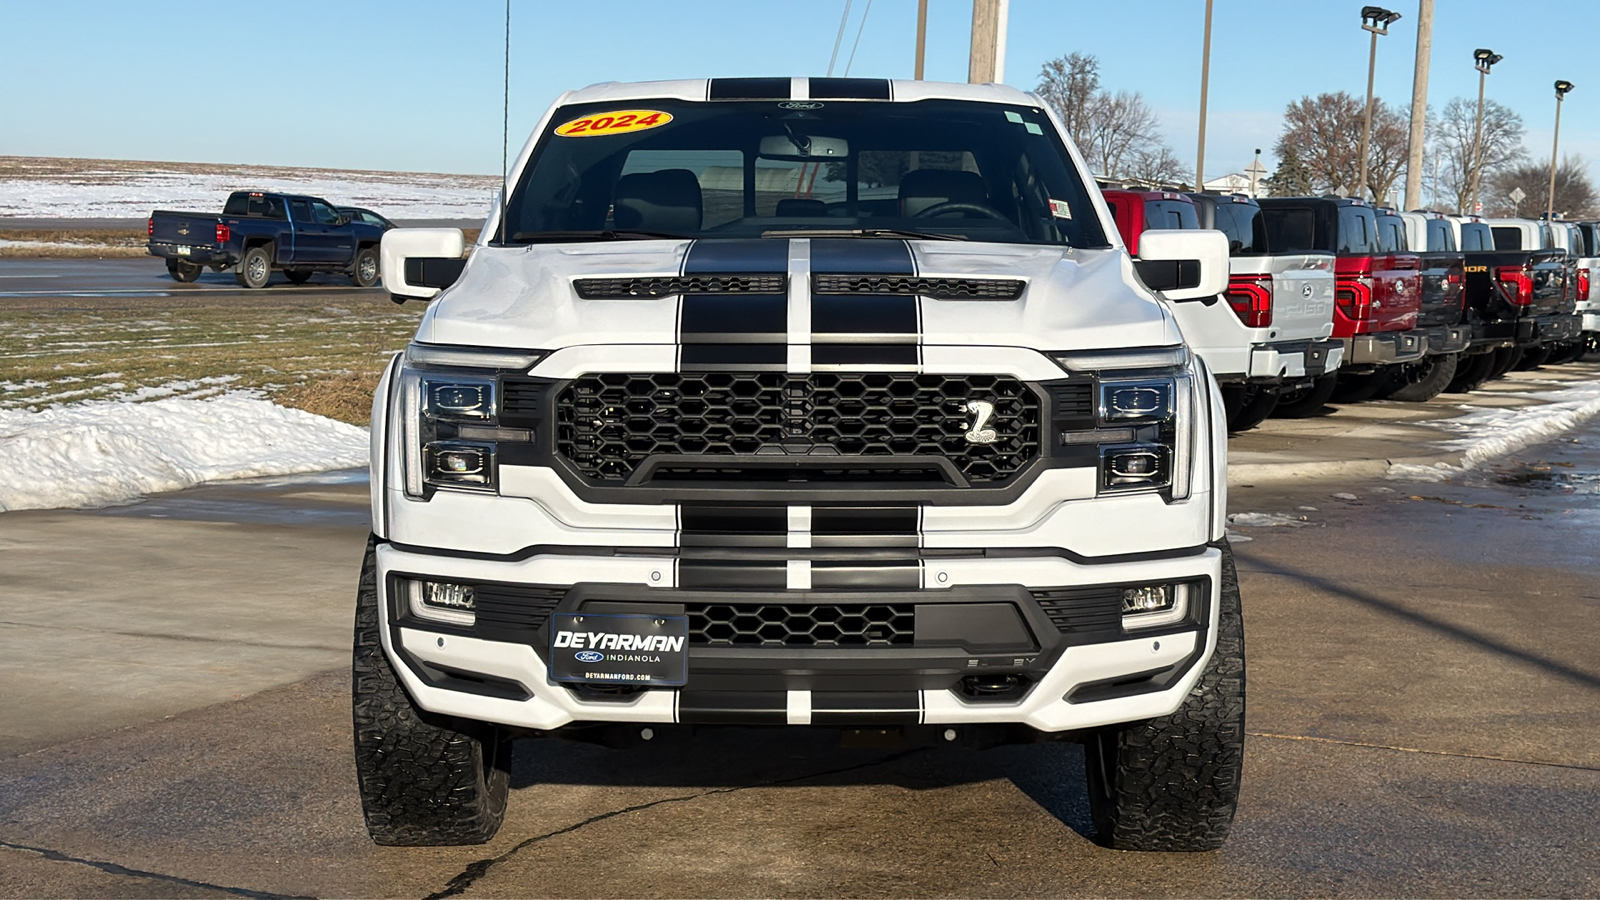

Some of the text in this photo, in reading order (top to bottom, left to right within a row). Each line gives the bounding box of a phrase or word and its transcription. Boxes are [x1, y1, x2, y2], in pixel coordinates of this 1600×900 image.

[784, 101, 817, 109] Ford
[565, 113, 662, 135] 2024
[1285, 301, 1326, 317] F-150
[553, 630, 685, 652] DEYARMAN
[579, 652, 661, 663] Ford INDIANOLA
[585, 672, 651, 681] DEYARMANFORD.COM
